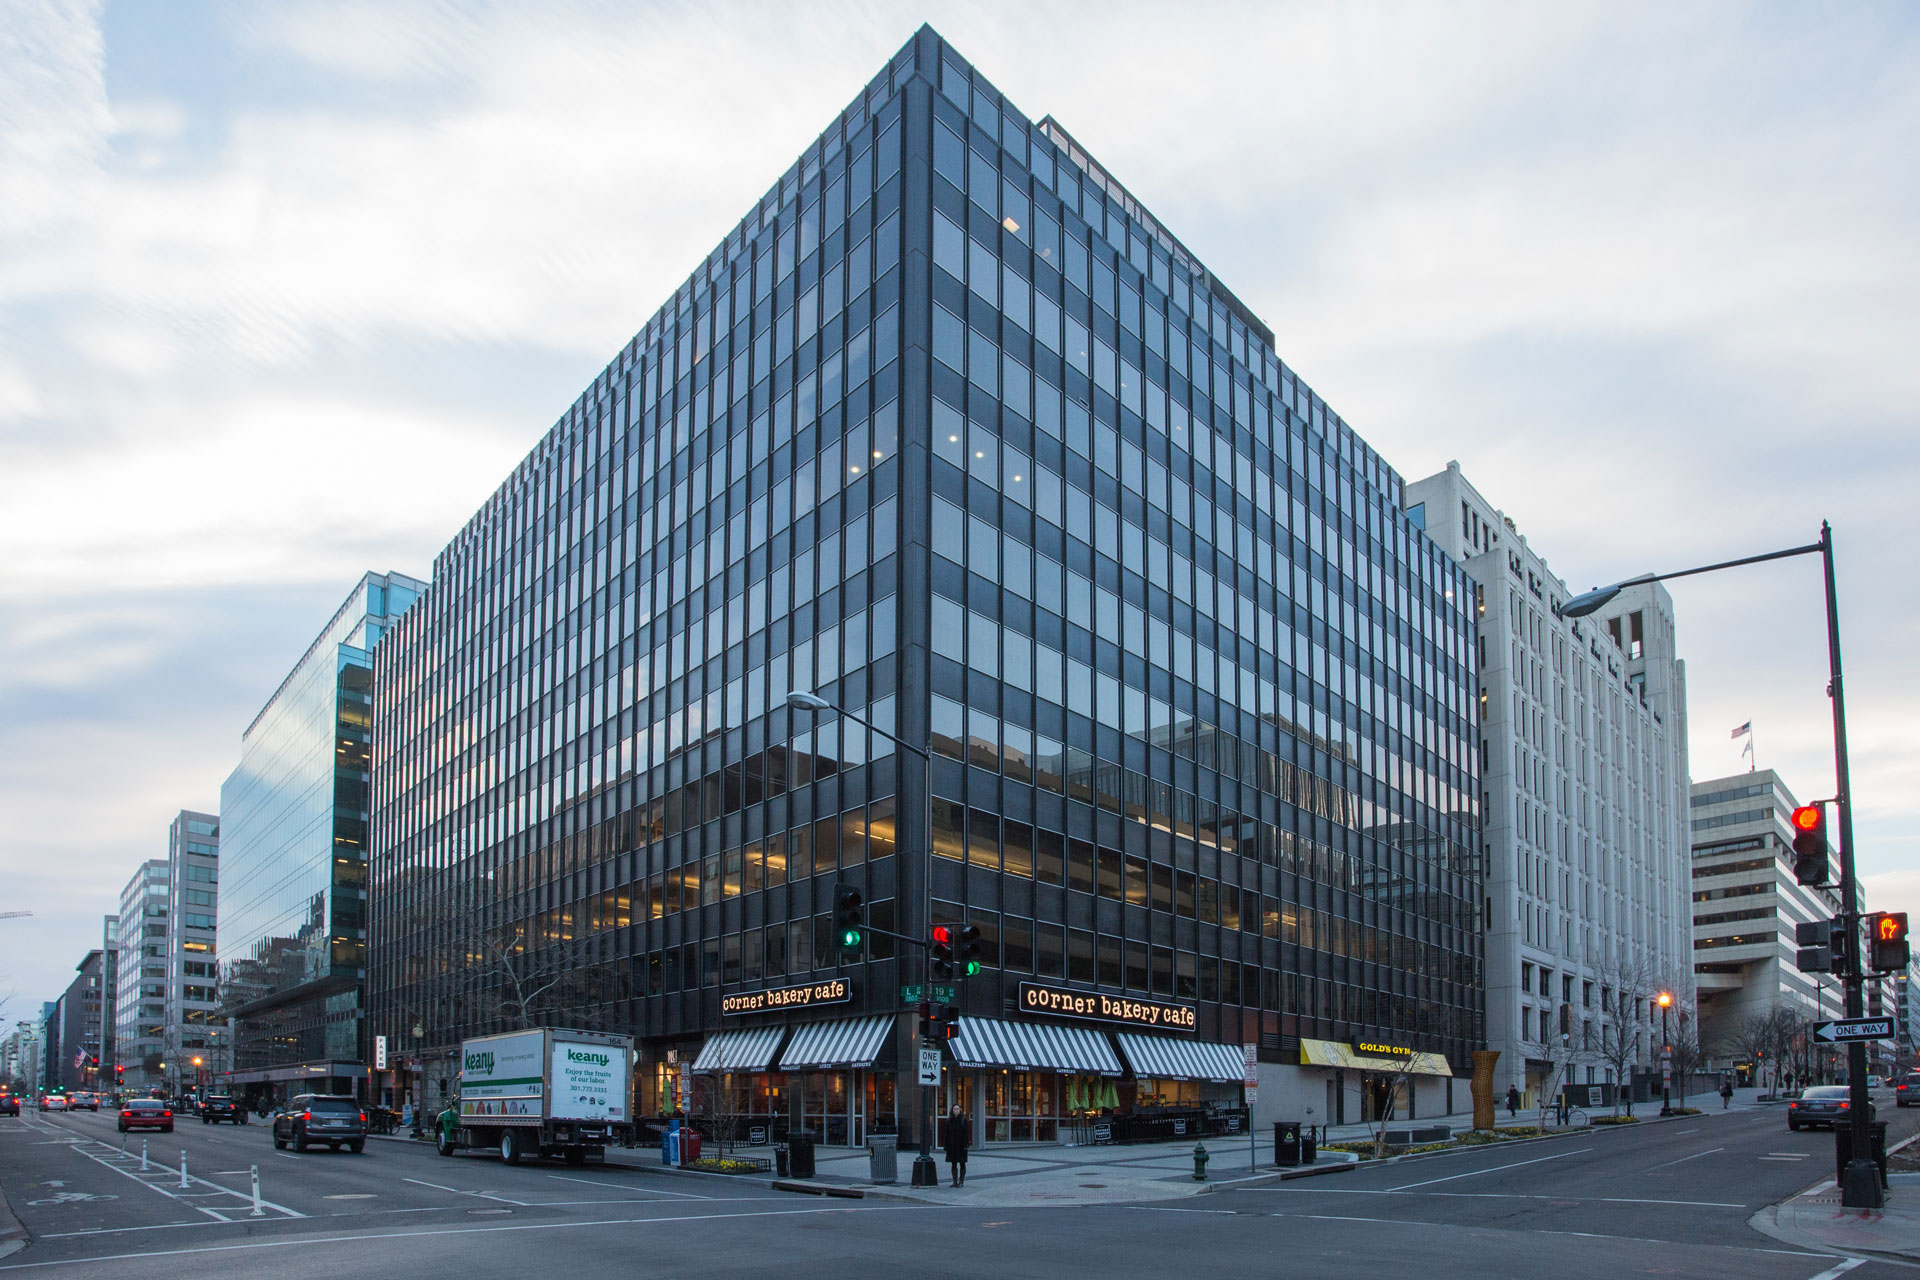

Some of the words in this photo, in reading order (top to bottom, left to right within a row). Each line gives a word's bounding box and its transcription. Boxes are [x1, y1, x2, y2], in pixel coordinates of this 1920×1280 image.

[723, 994, 764, 1011] corner
[766, 988, 812, 1004] bakery
[814, 981, 844, 999] cafe
[906, 987, 911, 996] L
[935, 987, 945, 996] 19
[1027, 989, 1096, 1014] corner
[1100, 995, 1160, 1024] bakery
[1163, 1007, 1194, 1026] cafe
[1835, 1025, 1858, 1036] ONE
[1861, 1023, 1885, 1034] WAY
[1359, 1042, 1391, 1054] GOLD'S
[1392, 1046, 1411, 1056] GYM
[464, 1049, 495, 1075] keany
[567, 1048, 610, 1067] keany
[922, 1051, 937, 1061] ONE
[921, 1061, 938, 1070] WAY
[565, 1068, 583, 1076] Enjoy
[594, 1070, 612, 1078] fruits
